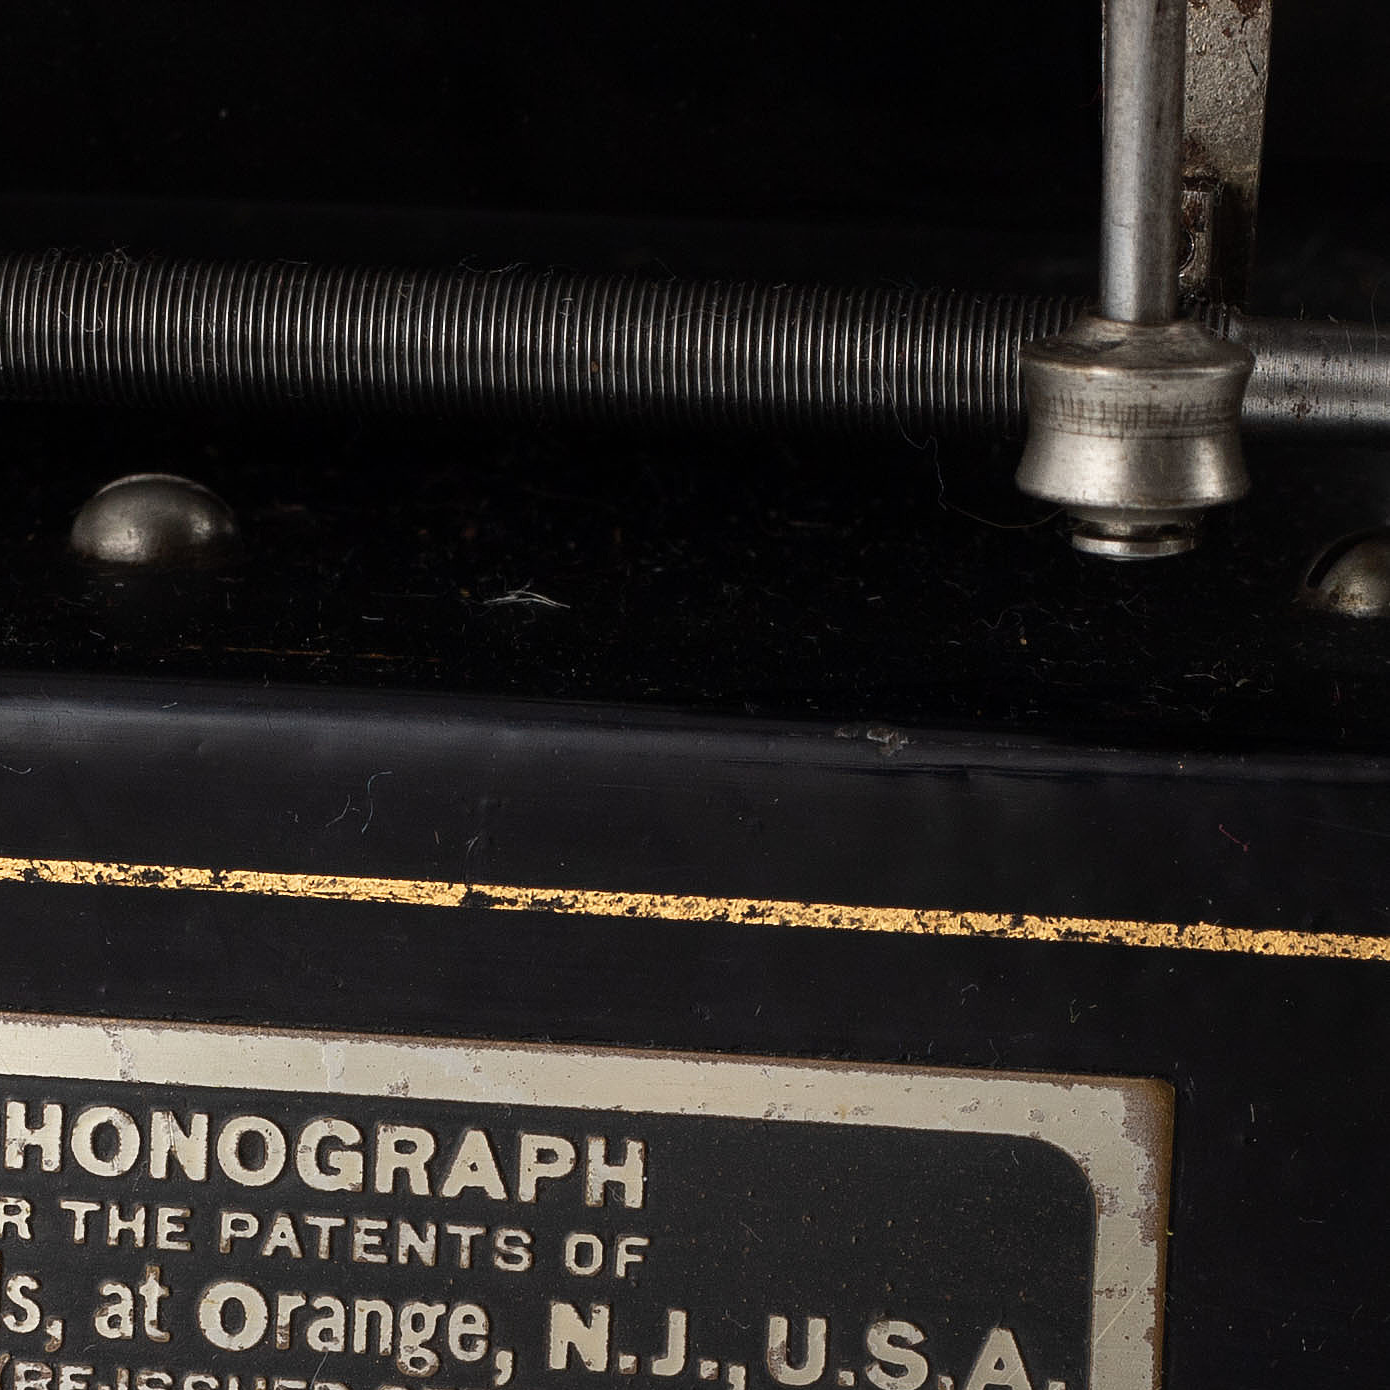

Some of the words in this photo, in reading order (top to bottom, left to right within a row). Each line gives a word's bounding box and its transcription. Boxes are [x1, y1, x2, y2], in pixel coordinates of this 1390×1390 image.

[58, 1197, 191, 1251] THE
[218, 1210, 532, 1272] PATENTS
[564, 1231, 650, 1279] OF
[92, 1263, 171, 1343] at
[196, 1279, 514, 1387] Orange,
